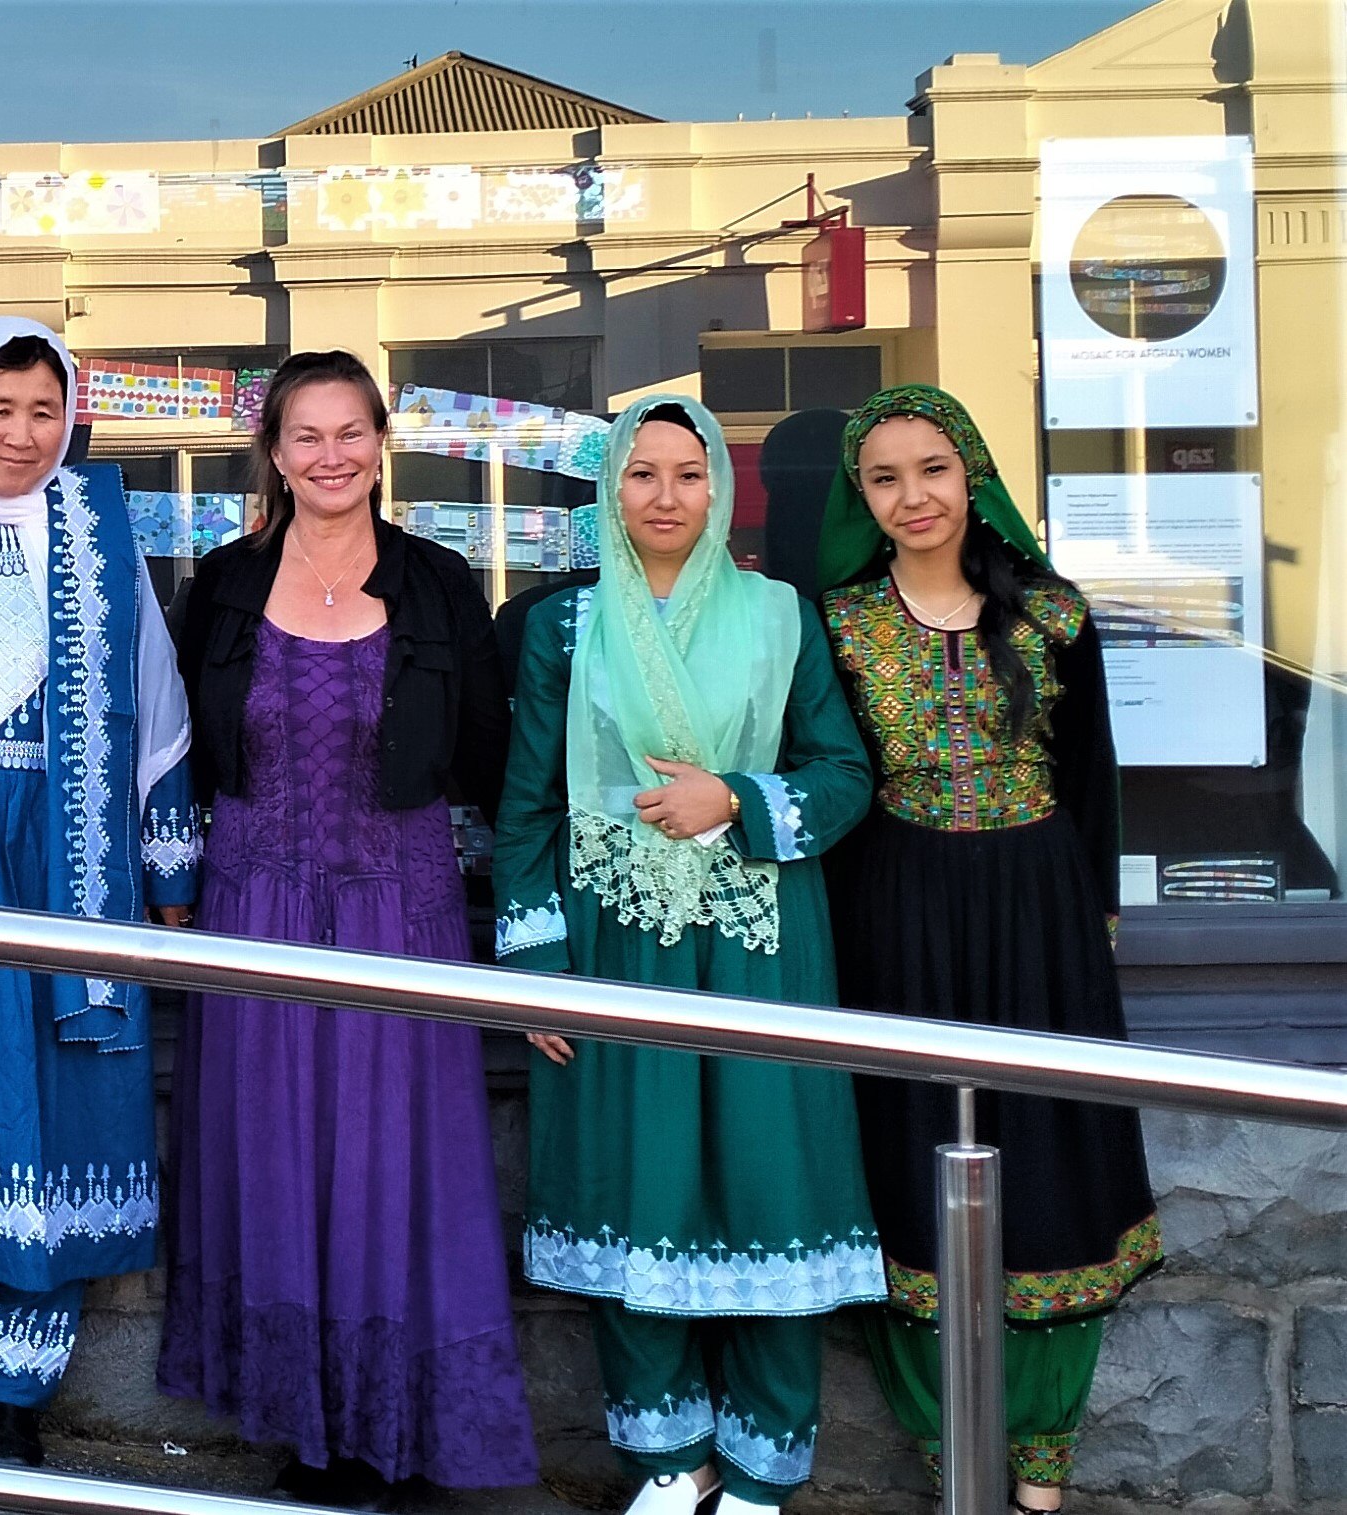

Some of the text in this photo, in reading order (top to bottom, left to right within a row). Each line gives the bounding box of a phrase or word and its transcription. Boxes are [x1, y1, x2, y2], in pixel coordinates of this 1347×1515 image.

[1071, 346, 1231, 360] MOSAIC FOR AFGHAN WOMEN
